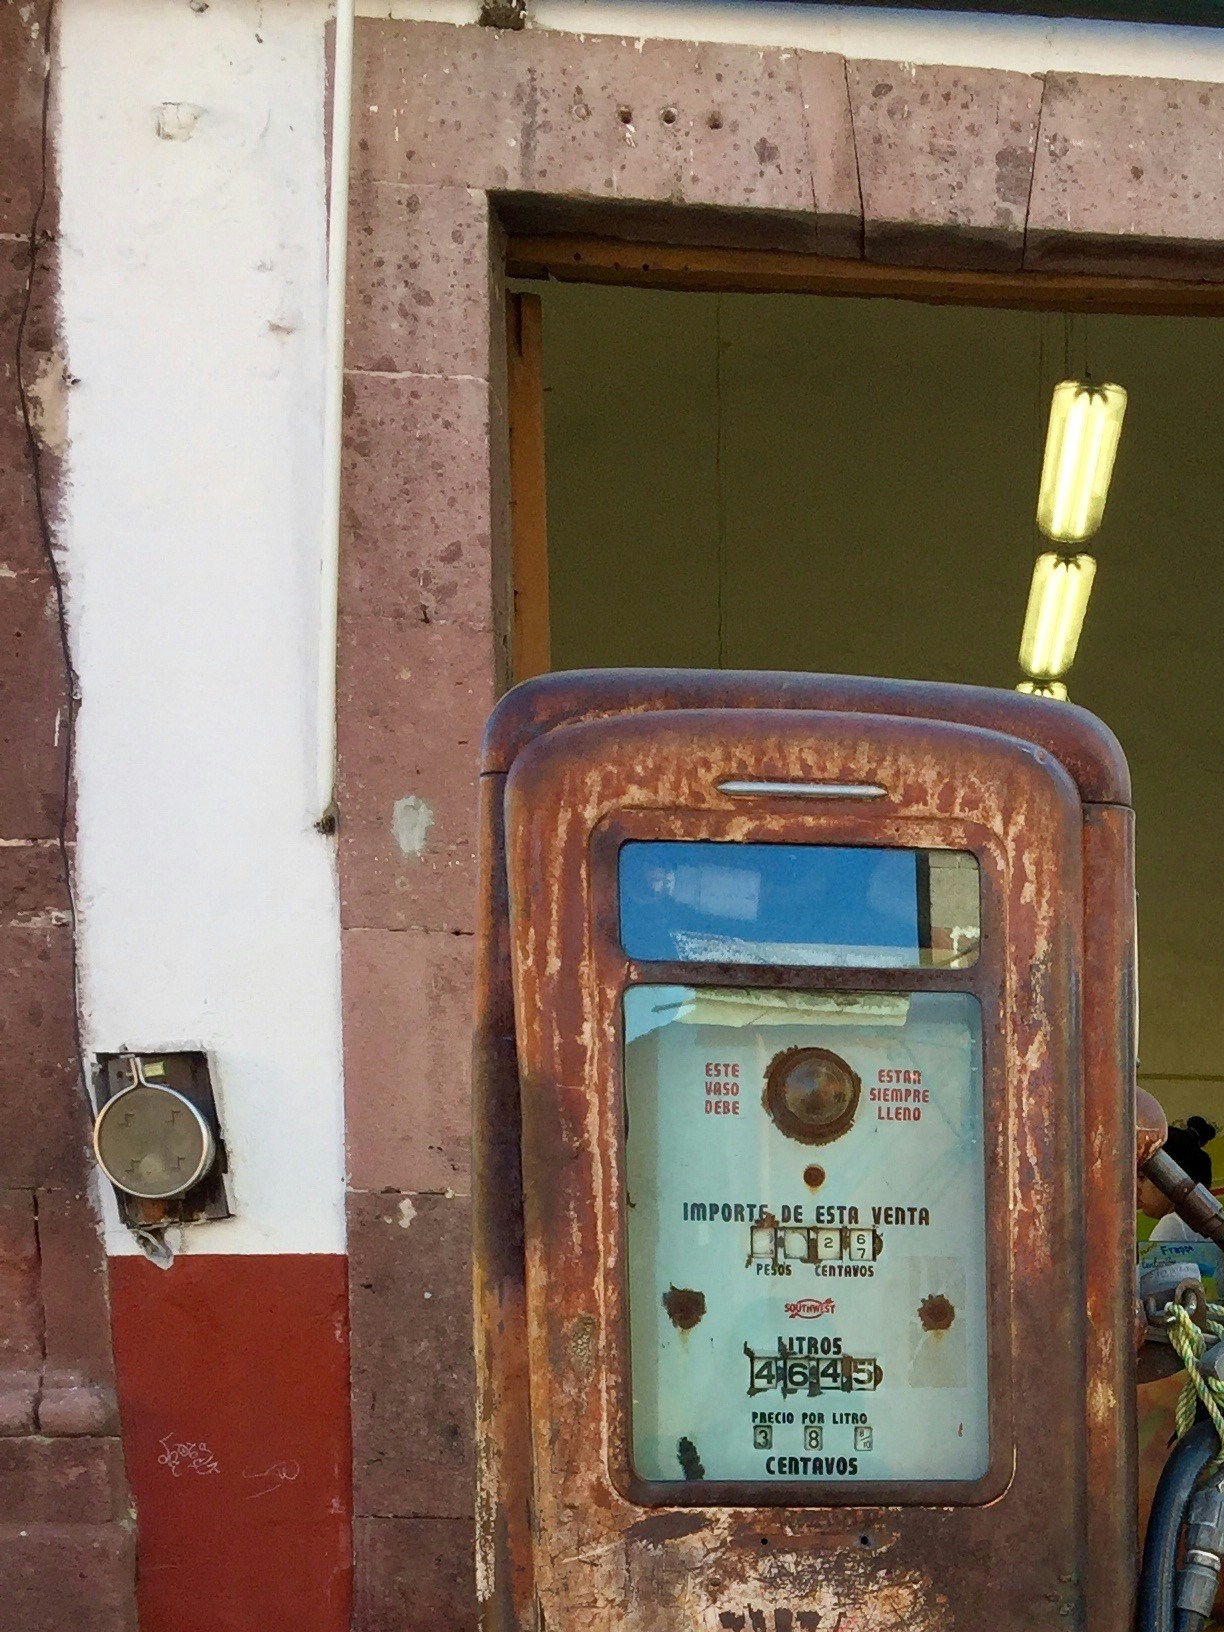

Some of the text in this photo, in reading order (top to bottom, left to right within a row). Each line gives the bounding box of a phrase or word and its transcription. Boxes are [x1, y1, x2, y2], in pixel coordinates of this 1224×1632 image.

[704, 1062, 740, 1078] ESTE
[877, 1069, 922, 1085] ESTAR
[704, 1081, 740, 1097] VASO
[869, 1088, 930, 1104] SIEMPRE
[704, 1100, 740, 1115] DEBE
[877, 1106, 922, 1121] LLENO
[781, 1204, 804, 1224] DE
[815, 1205, 859, 1225] ESTA
[871, 1206, 930, 1226] VENTA
[756, 1263, 875, 1278] PESOS CENTAVOS
[784, 1301, 836, 1315] SOUTHWEST
[778, 1336, 842, 1355] LITROS
[752, 1411, 868, 1425] PRECIO POR LITRO
[766, 1456, 858, 1476] CENTAVOS
